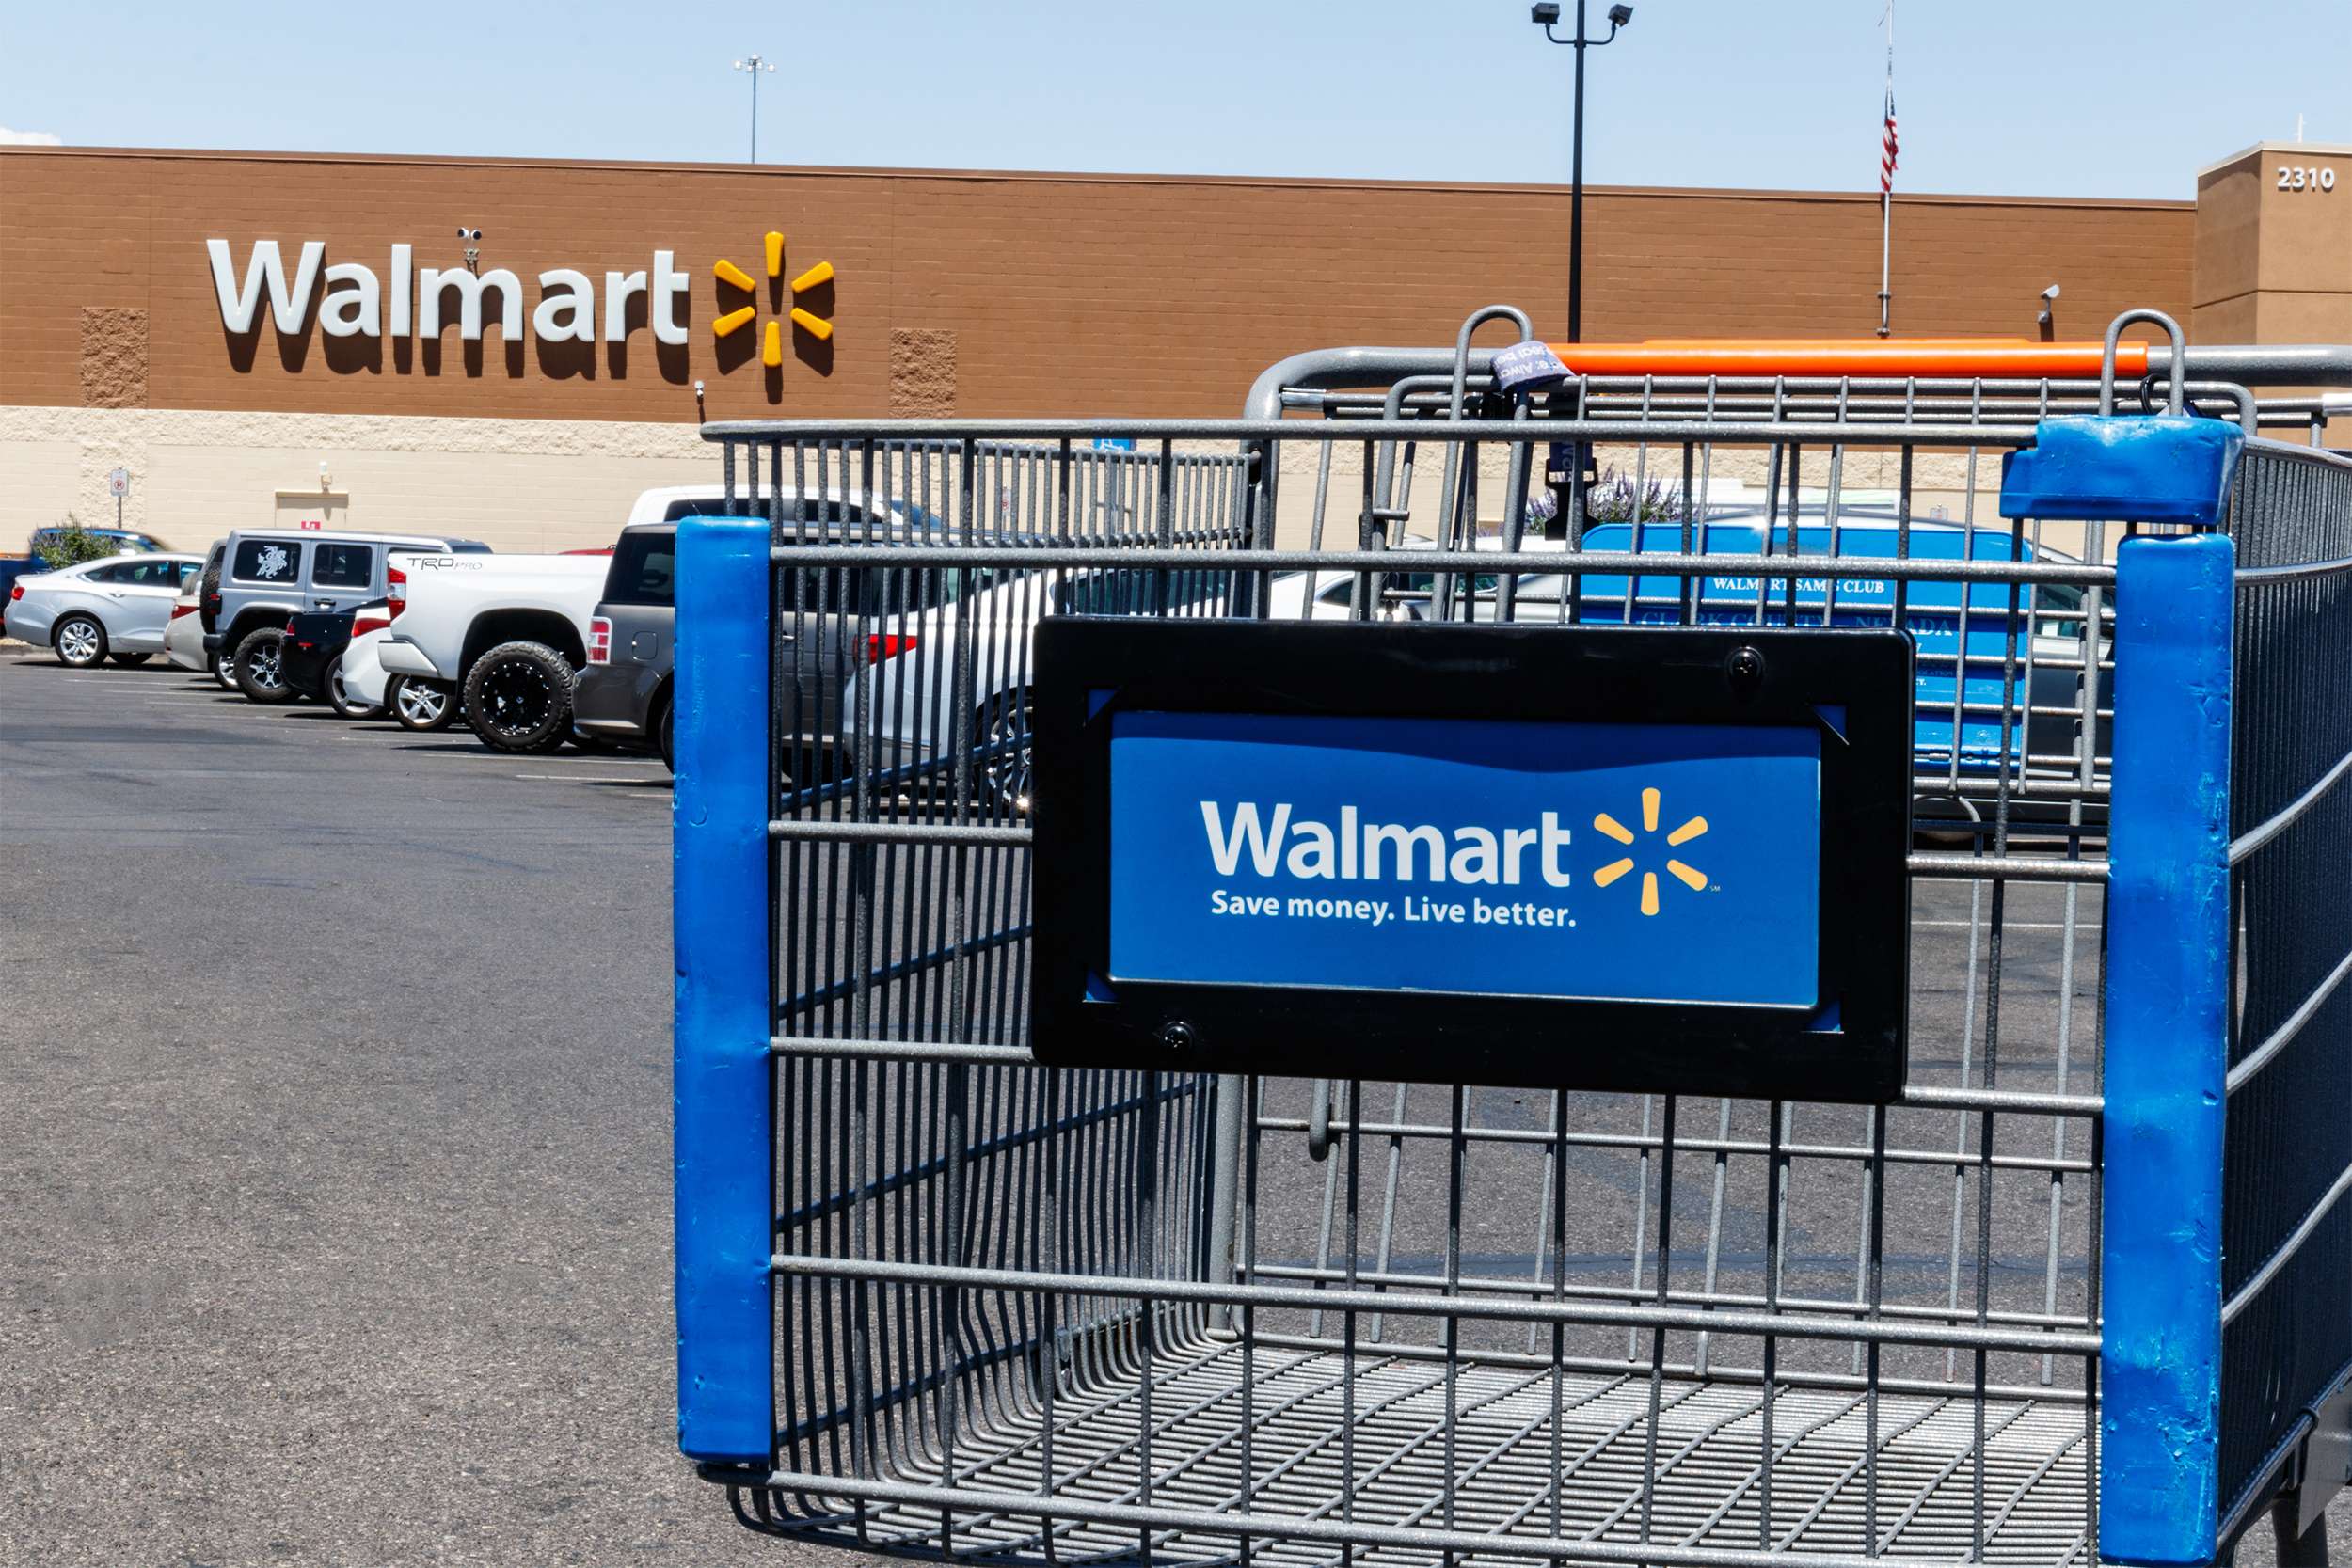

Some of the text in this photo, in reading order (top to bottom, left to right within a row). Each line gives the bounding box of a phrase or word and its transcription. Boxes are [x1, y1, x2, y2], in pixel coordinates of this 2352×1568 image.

[2277, 166, 2335, 188] 2310
[206, 239, 690, 344] Walmart
[406, 557, 483, 571] TRD PRO
[1843, 580, 1884, 593] CLUB
[1641, 611, 1724, 626] CLRK
[1854, 616, 1953, 636] NEADA
[1200, 800, 1571, 888] Walmart
[1211, 889, 1577, 927] Save money. Live better.
